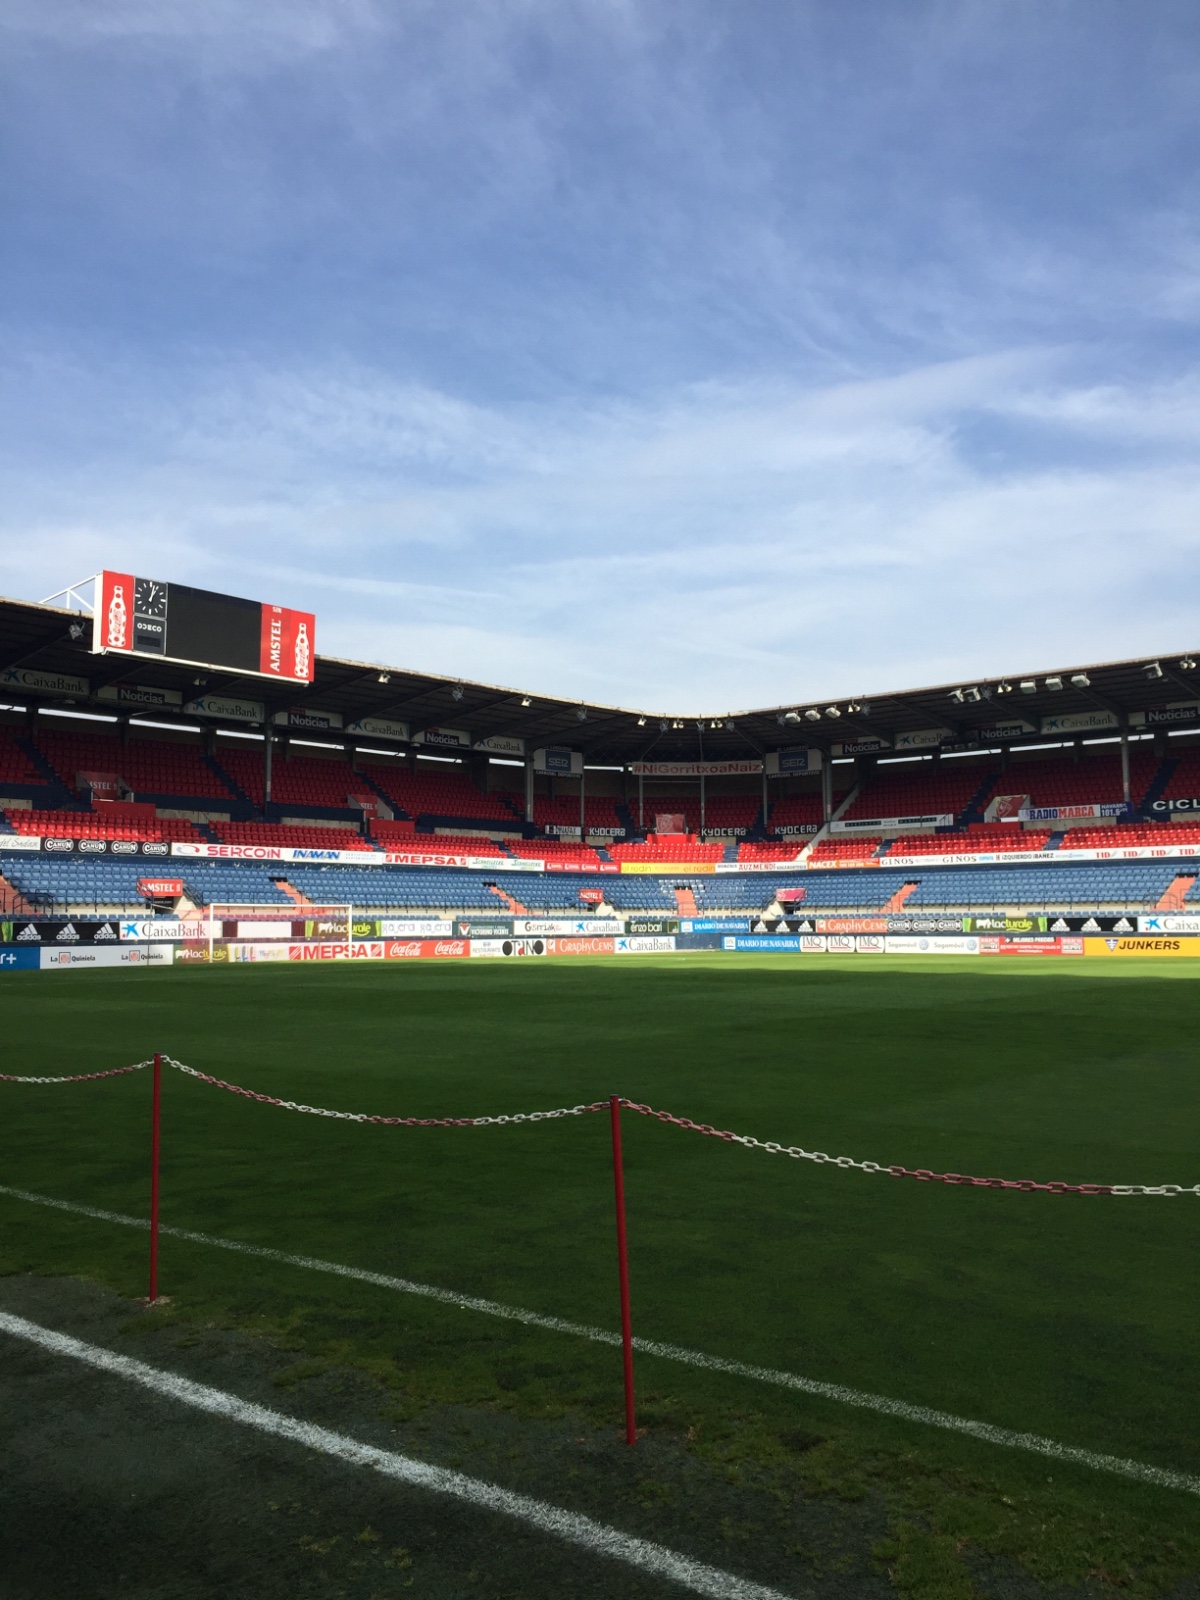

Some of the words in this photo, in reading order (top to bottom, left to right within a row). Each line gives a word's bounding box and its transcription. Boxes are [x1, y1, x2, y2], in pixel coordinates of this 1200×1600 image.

[270, 619, 282, 672] AMSTEL
[22, 672, 84, 693] CaixaBank
[120, 689, 163, 704] Noticias
[208, 702, 257, 718] CaixaBank
[1148, 709, 1196, 722] Noticias
[290, 713, 328, 728] Noticias
[1061, 714, 1113, 728] CaixaBank
[364, 722, 404, 737] CaixaBank
[981, 728, 1021, 738] Noticias
[426, 733, 458, 745] Noticias
[487, 739, 521, 752] CaixaBank
[844, 742, 879, 753] Noticias
[634, 763, 760, 774] #NiGorritxoaNaiz
[394, 855, 457, 865] MEPSA
[809, 860, 837, 868] NACEX
[882, 858, 914, 866] GINOS
[942, 856, 977, 864] GINOS
[142, 923, 206, 937] CaixaBank
[586, 922, 622, 932] CaixaBank
[992, 920, 1033, 929] lacturale
[390, 942, 422, 956] Coca-Cola
[435, 941, 463, 955] Coca-Cola
[628, 939, 672, 951] CaixaBank
[767, 942, 798, 950] NAVARRA
[1119, 941, 1180, 950] JUNKERS
[189, 949, 227, 958] lactuale
[304, 944, 367, 960] MEPSA
